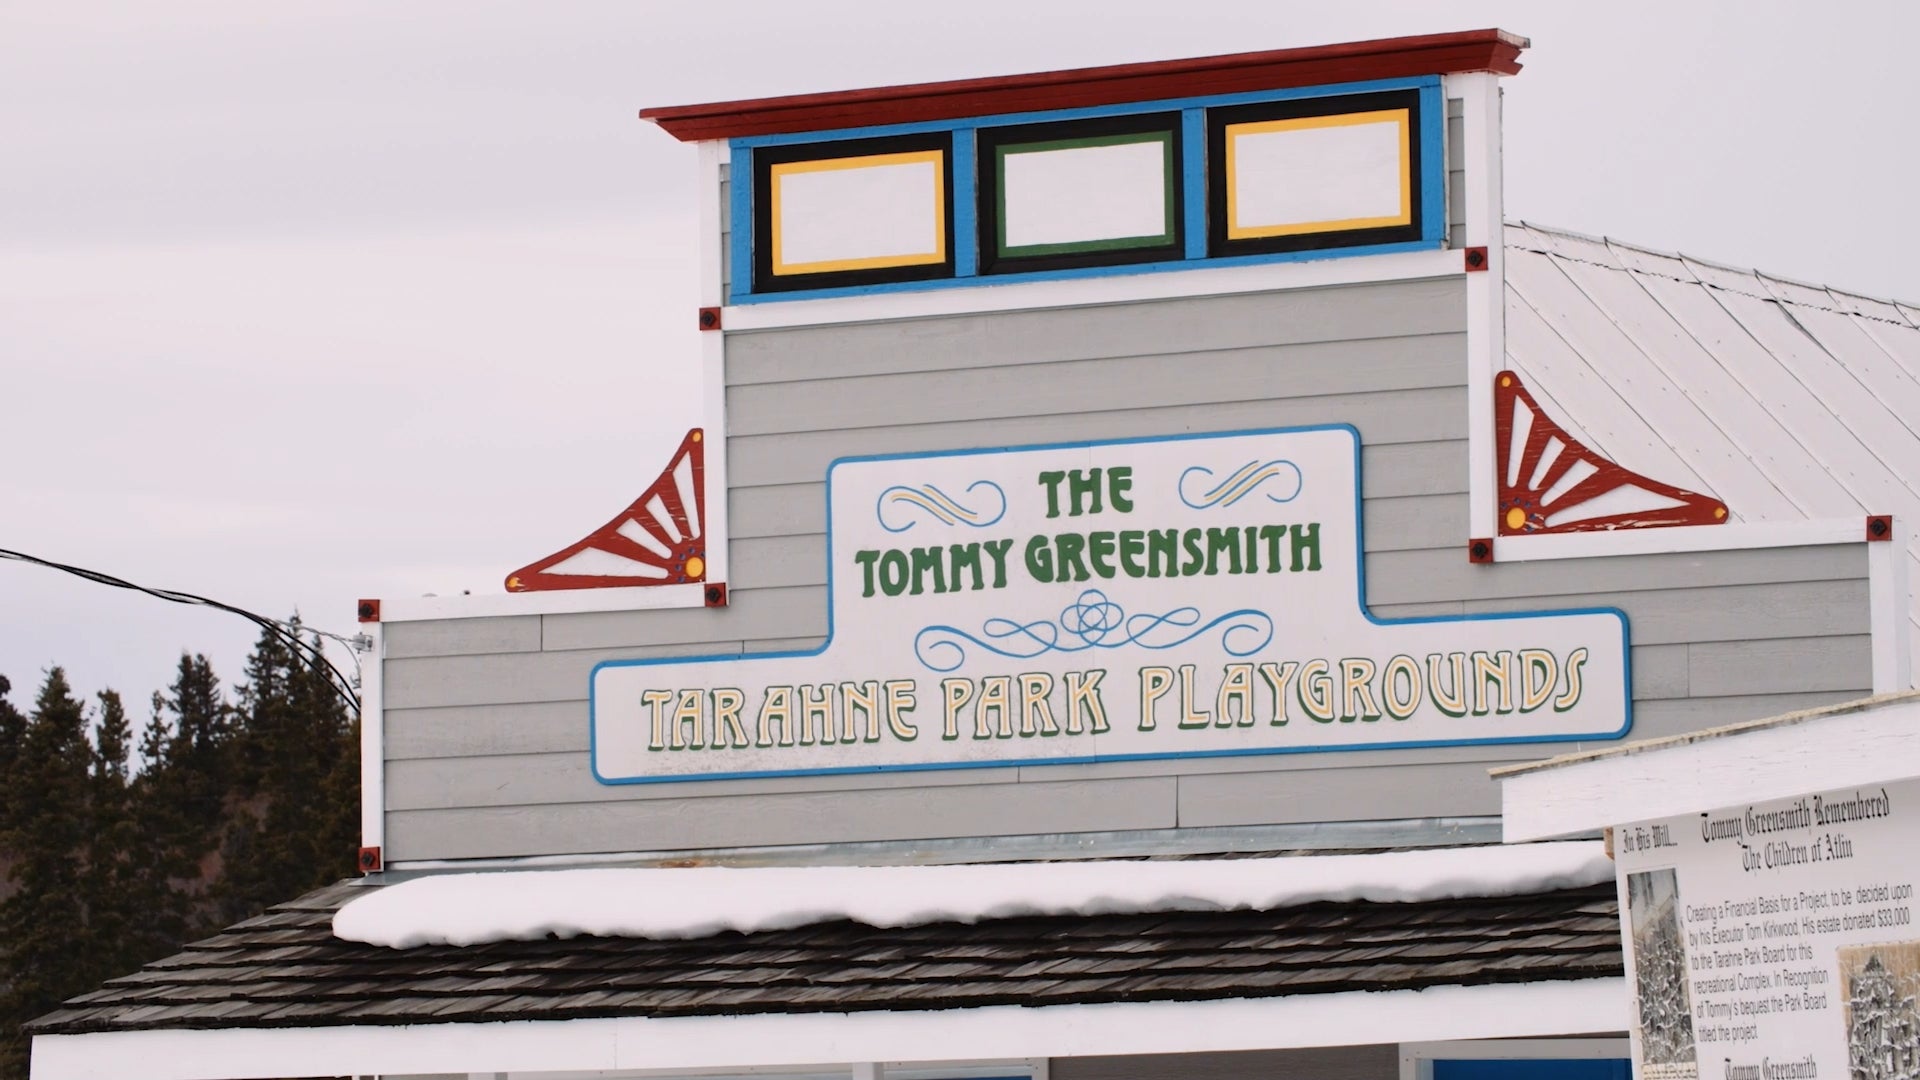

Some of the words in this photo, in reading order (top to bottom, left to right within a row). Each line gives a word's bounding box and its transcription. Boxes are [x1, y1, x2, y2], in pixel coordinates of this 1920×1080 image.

[1038, 466, 1134, 518] THE
[854, 538, 1014, 598] TOMMY
[1024, 523, 1322, 583] GREENSMITH
[641, 680, 918, 752] TARAHNE
[941, 668, 1110, 741] PARK
[1137, 647, 1588, 732] PLAYGROUNDS
[1701, 812, 1743, 845] Tommy
[1745, 797, 1811, 836] Greensmith
[1814, 788, 1890, 826] Remembered
[1742, 844, 1762, 876] The
[1765, 840, 1808, 874] Children
[1811, 836, 1822, 863] of
[1825, 833, 1853, 861] Atlin
[1686, 902, 1718, 925] Creating
[1719, 905, 1724, 920] a
[1724, 899, 1757, 918] Financial
[1759, 895, 1780, 914] Basis
[1781, 893, 1791, 912] for
[1793, 896, 1799, 911] a
[1831, 889, 1839, 906] to
[1841, 887, 1852, 906] be
[1856, 882, 1889, 904] decided
[1892, 883, 1913, 904] upon
[1689, 928, 1699, 951] by
[1700, 926, 1711, 945] his
[1711, 925, 1744, 944] Executor
[1745, 922, 1761, 941] Tom
[1802, 915, 1816, 935] His
[1816, 915, 1840, 934] estate
[1842, 910, 1876, 932] donated
[1877, 906, 1911, 928] $33,000
[1691, 953, 1700, 971] to
[1700, 950, 1713, 970] the
[1713, 949, 1743, 969] Tarahne
[1743, 945, 1761, 966] Park
[1761, 944, 1786, 964] Board
[1786, 943, 1798, 962] for
[1798, 941, 1814, 961] this
[1693, 973, 1737, 995] recreational
[1773, 968, 1782, 988] In
[1782, 966, 1830, 991] Recognition
[1696, 999, 1704, 1020] of
[1704, 998, 1740, 1022] Tommy's
[1740, 996, 1771, 1019] bequest
[1770, 994, 1784, 1013] the
[1784, 993, 1802, 1013] Park
[1802, 990, 1828, 1011] Board
[1718, 1023, 1731, 1042] the
[1731, 1021, 1759, 1046] project
[1762, 1054, 1818, 1080] Greensmith
